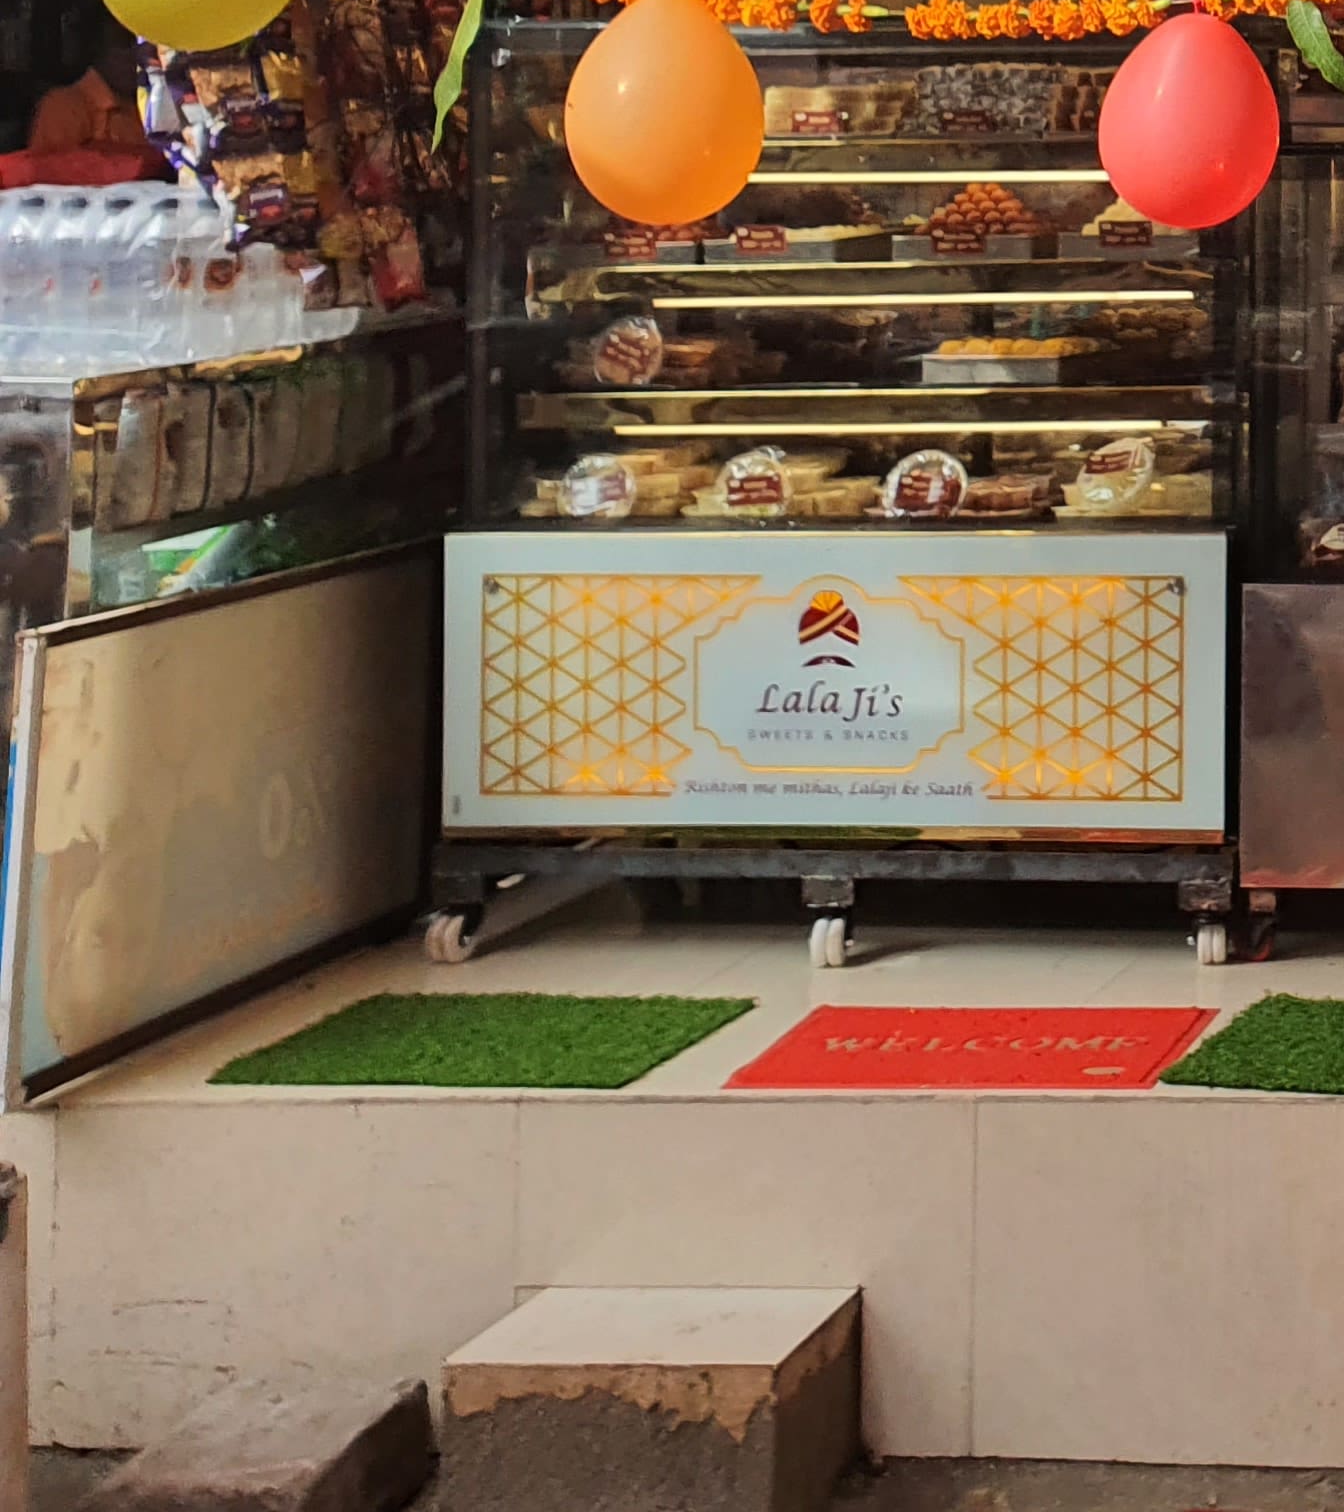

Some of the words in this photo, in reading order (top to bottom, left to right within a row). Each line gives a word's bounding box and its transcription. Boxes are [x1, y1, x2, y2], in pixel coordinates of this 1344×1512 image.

[755, 679, 842, 714] Lala
[841, 682, 904, 723] Ji's
[746, 728, 814, 741] SWEETS
[842, 728, 911, 741] SNACKS
